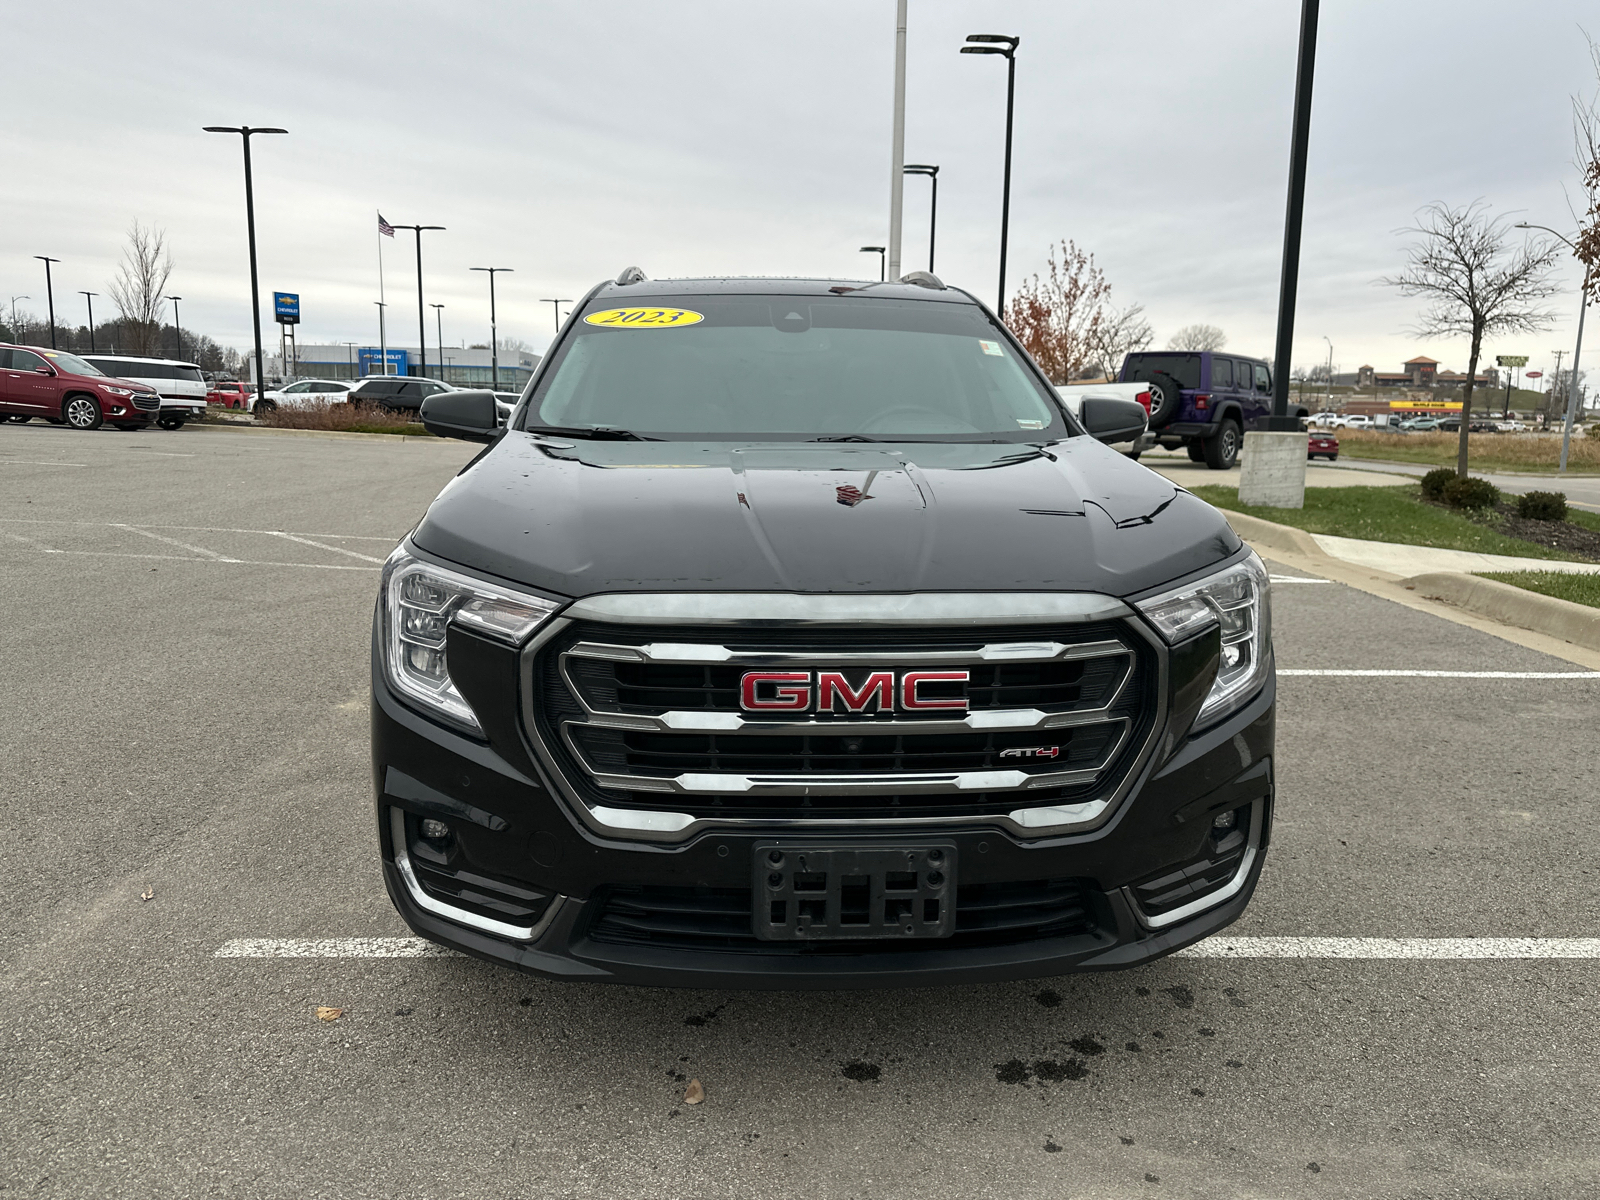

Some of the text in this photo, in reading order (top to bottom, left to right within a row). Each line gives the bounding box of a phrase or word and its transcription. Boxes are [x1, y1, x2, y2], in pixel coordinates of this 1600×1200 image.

[600, 311, 684, 323] 2023
[740, 671, 970, 712] GMC
[1000, 746, 1059, 758] AT4
